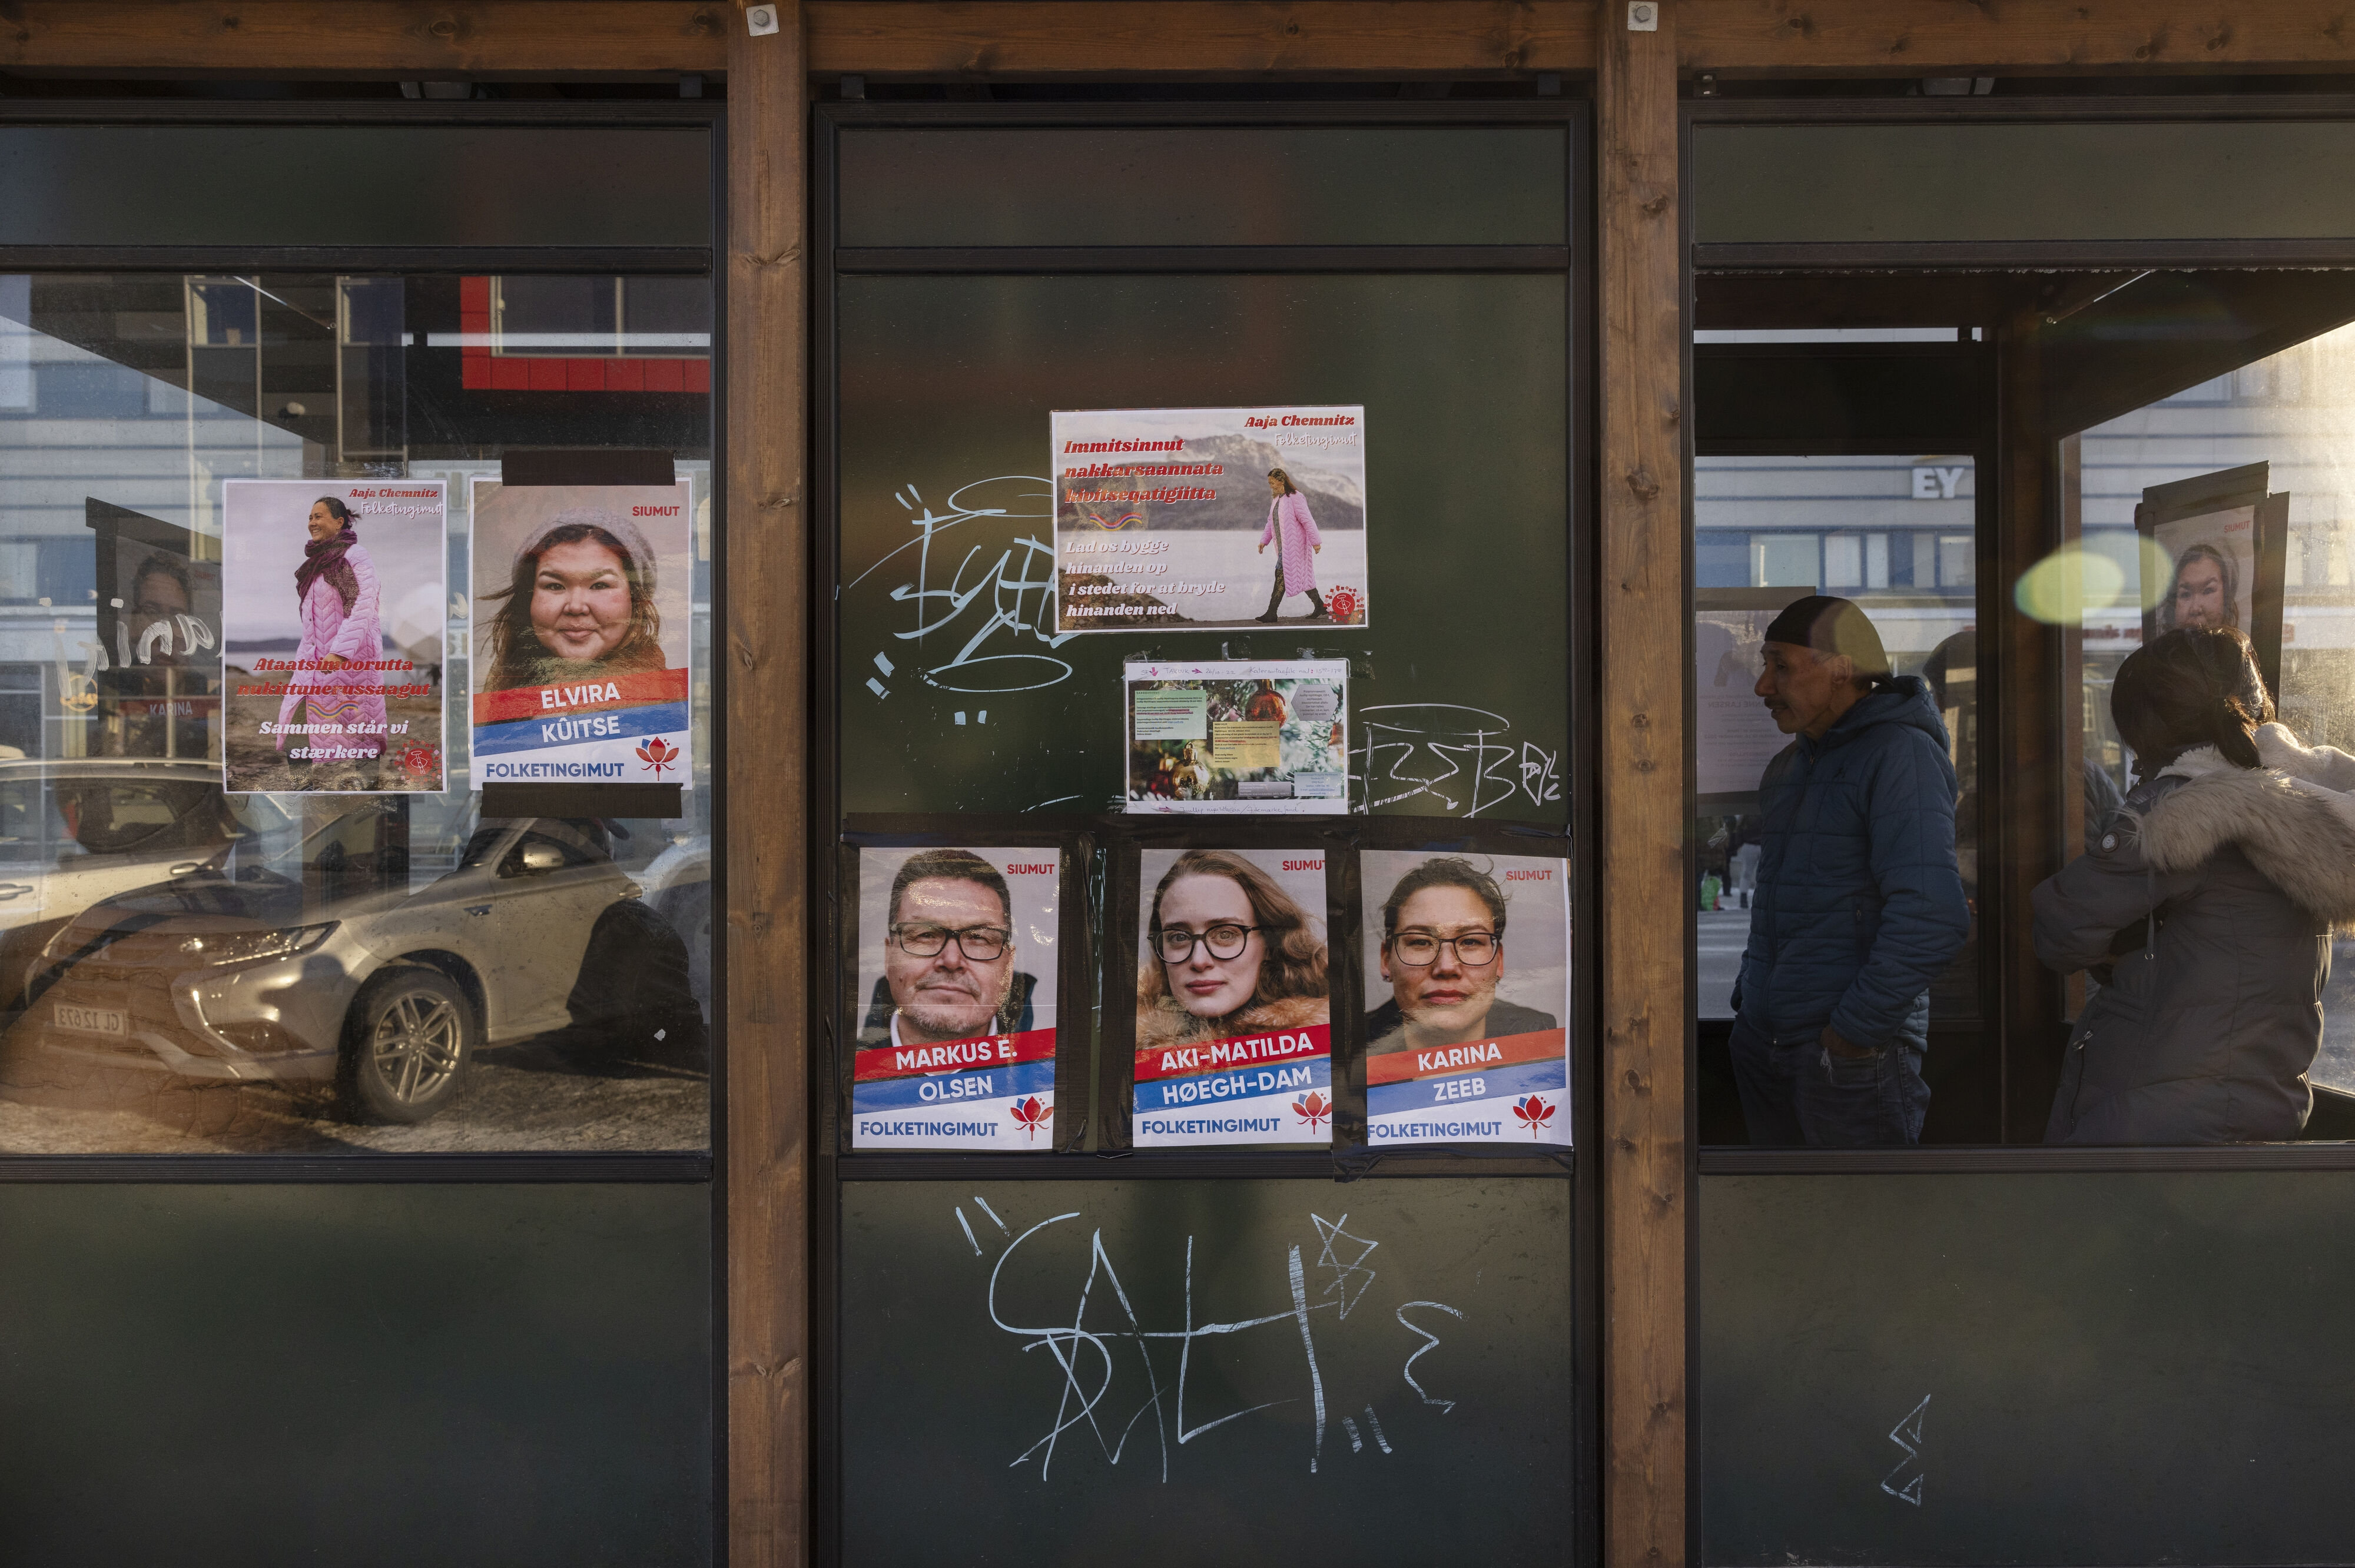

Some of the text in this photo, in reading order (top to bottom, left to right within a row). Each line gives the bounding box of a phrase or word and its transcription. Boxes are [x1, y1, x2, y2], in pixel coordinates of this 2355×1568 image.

[1245, 414, 1355, 429] Aaja Chemnitz
[1064, 438, 1185, 454] Immitsinnut
[1064, 463, 1224, 479] nakkarsaannata
[1912, 467, 1965, 499] EY
[349, 488, 438, 499] Aaja Chemnitz
[1064, 486, 1217, 504] kivitseqatigiitta
[632, 506, 680, 517] SIUMUT
[2224, 520, 2251, 533] SIUMUT
[1065, 540, 1169, 555] Lad os bygge
[1065, 562, 1167, 575] hinanden op
[1069, 580, 1226, 596] i stedet for at bryde
[1066, 603, 1178, 617] hinanden ned
[253, 657, 413, 672] Ataatsimoorutta
[236, 682, 431, 699] nukittunerussaagut
[541, 682, 621, 709] ELVIRA
[150, 701, 193, 716] KARINA
[259, 720, 409, 735] Sammen står vi
[542, 715, 621, 743] KÛITSE
[289, 745, 378, 759] stærkere
[486, 762, 624, 778] FOLKETINGIMUT
[1007, 863, 1054, 875] SIUMUT
[1506, 871, 1552, 881] SIUMUT
[895, 1039, 1017, 1070] MARKUS E.
[1161, 1032, 1314, 1071] AKI-MATILDA
[1417, 1042, 1502, 1071] KARINA
[918, 1075, 993, 1101] OLSEN
[1162, 1066, 1312, 1105] HØEGH-DAM
[1433, 1077, 1486, 1101] ZEEB
[861, 1121, 998, 1137] FOLKETINGIMUT
[1142, 1118, 1281, 1134] FOLKETINGIMUT
[1367, 1121, 1502, 1138] FOLKETINGIMUT
